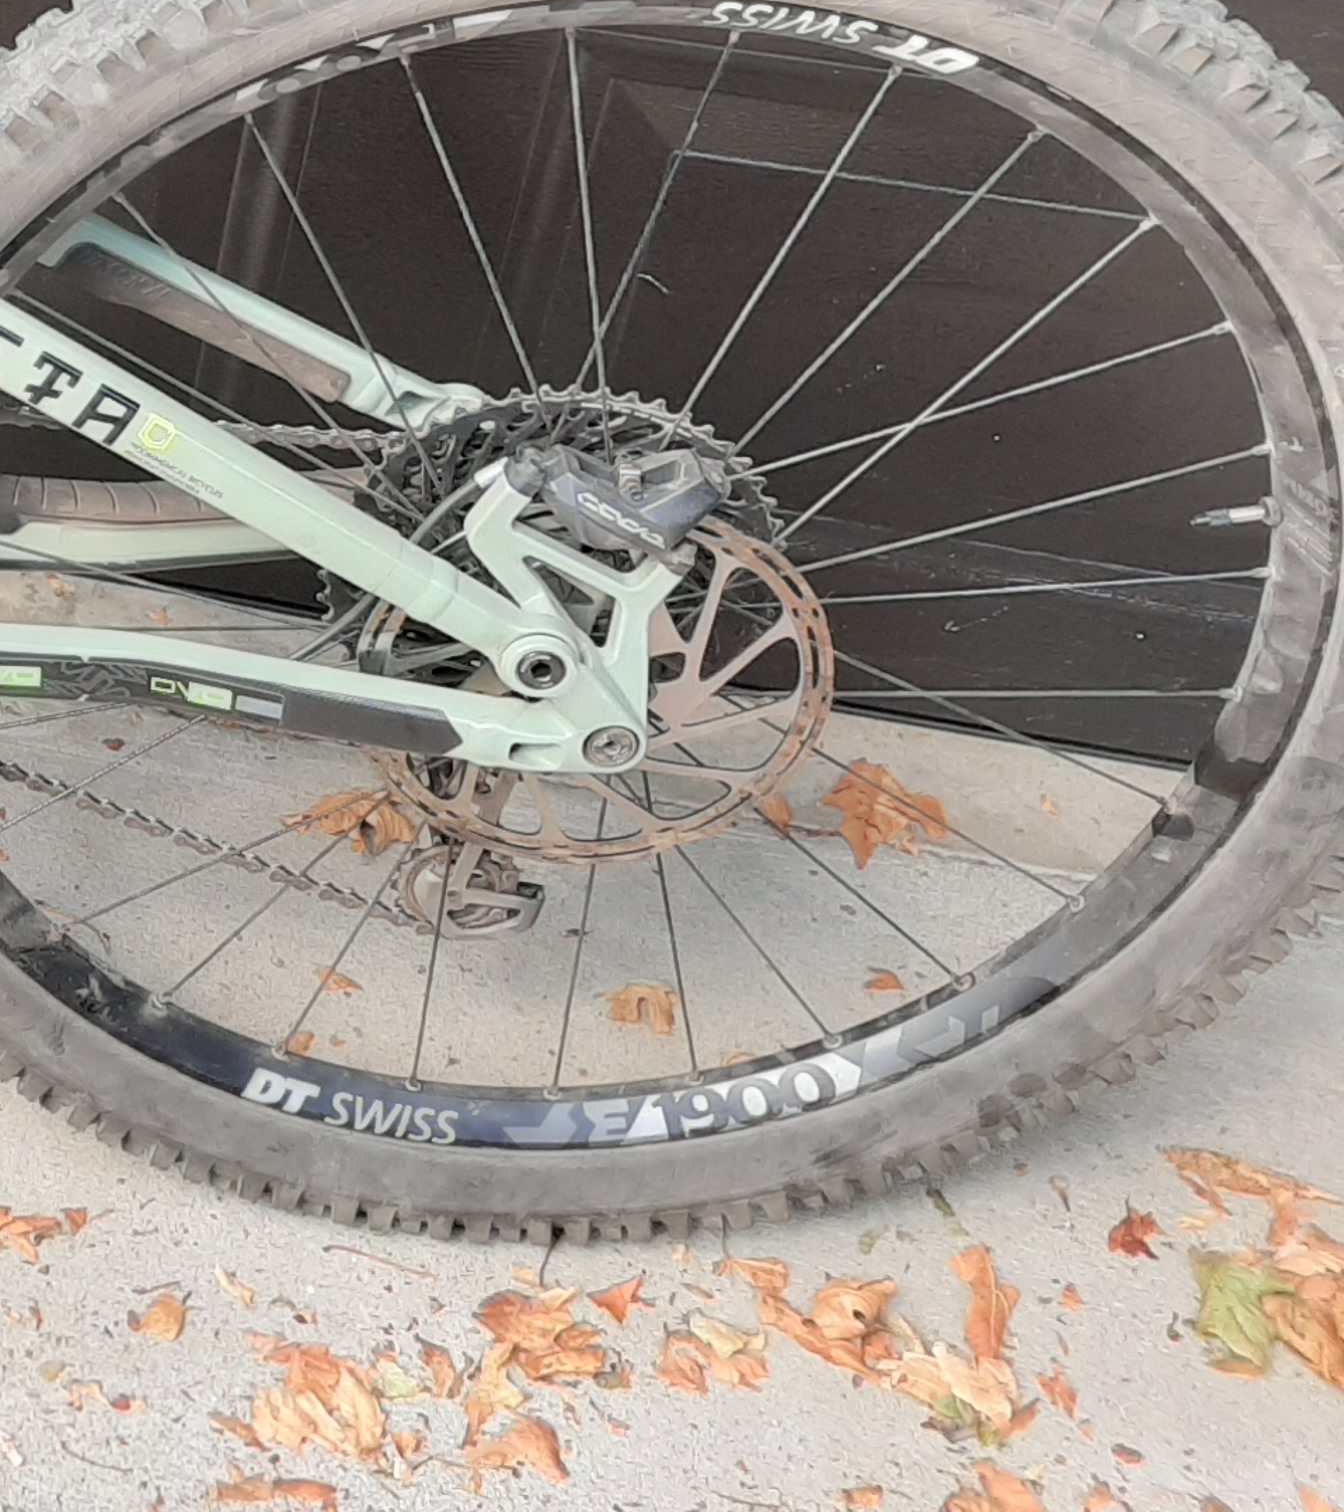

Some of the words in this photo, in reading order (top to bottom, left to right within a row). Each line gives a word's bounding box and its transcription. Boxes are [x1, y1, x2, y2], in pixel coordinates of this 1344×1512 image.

[703, 1, 879, 45] SWISS
[872, 34, 980, 75] DT
[242, 1067, 321, 1115] DT
[323, 1091, 460, 1146] SWISS
